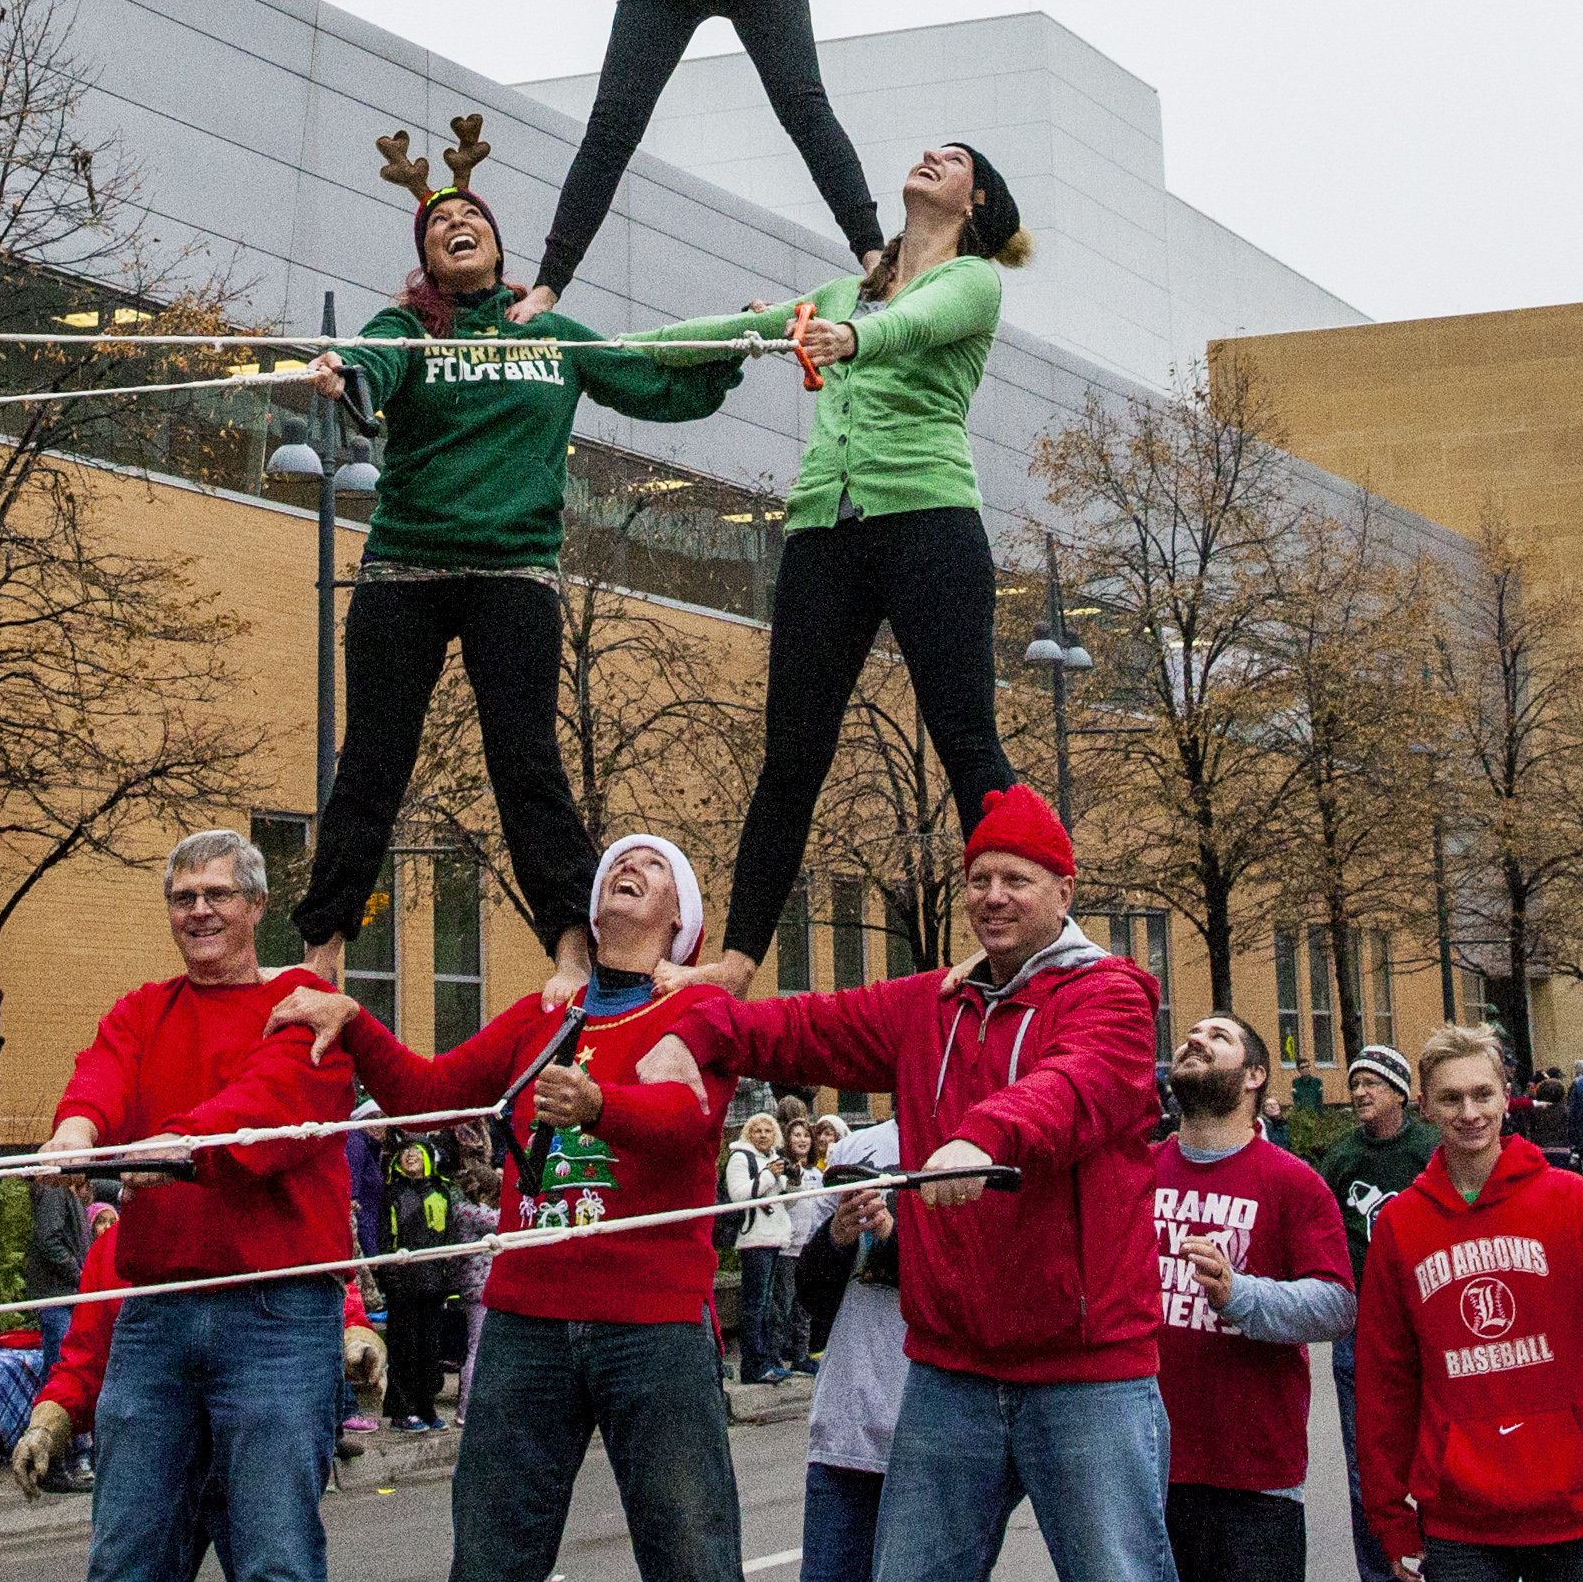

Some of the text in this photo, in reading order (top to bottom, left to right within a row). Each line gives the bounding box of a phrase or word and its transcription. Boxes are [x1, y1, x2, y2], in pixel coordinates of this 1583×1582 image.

[1153, 1187, 1259, 1231] RAND
[1414, 1235, 1550, 1304] RED ARROWS
[1444, 1332, 1555, 1379] BASEBALL
